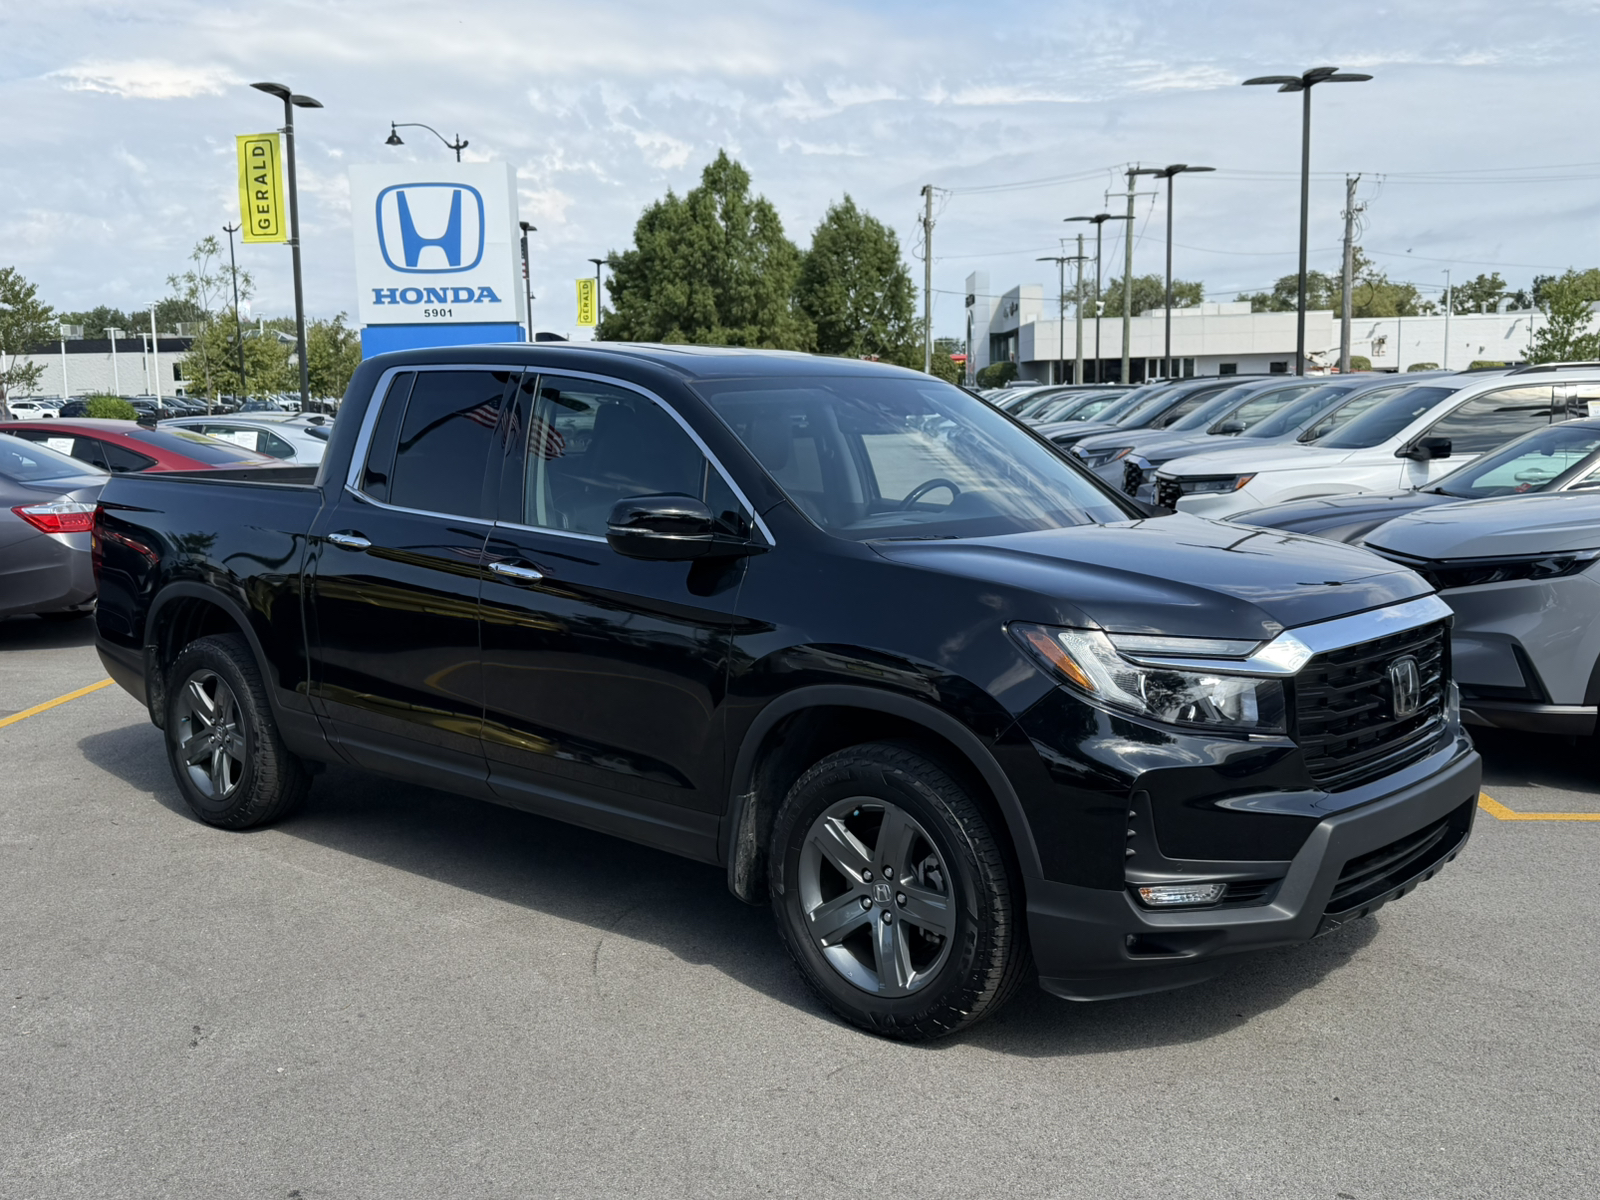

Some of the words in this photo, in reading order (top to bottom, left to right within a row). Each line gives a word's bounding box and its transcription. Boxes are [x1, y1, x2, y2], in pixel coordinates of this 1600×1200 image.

[252, 146, 271, 230] GERALD
[372, 286, 502, 305] HONDA
[582, 283, 590, 321] GERALD
[424, 308, 453, 318] 5901
